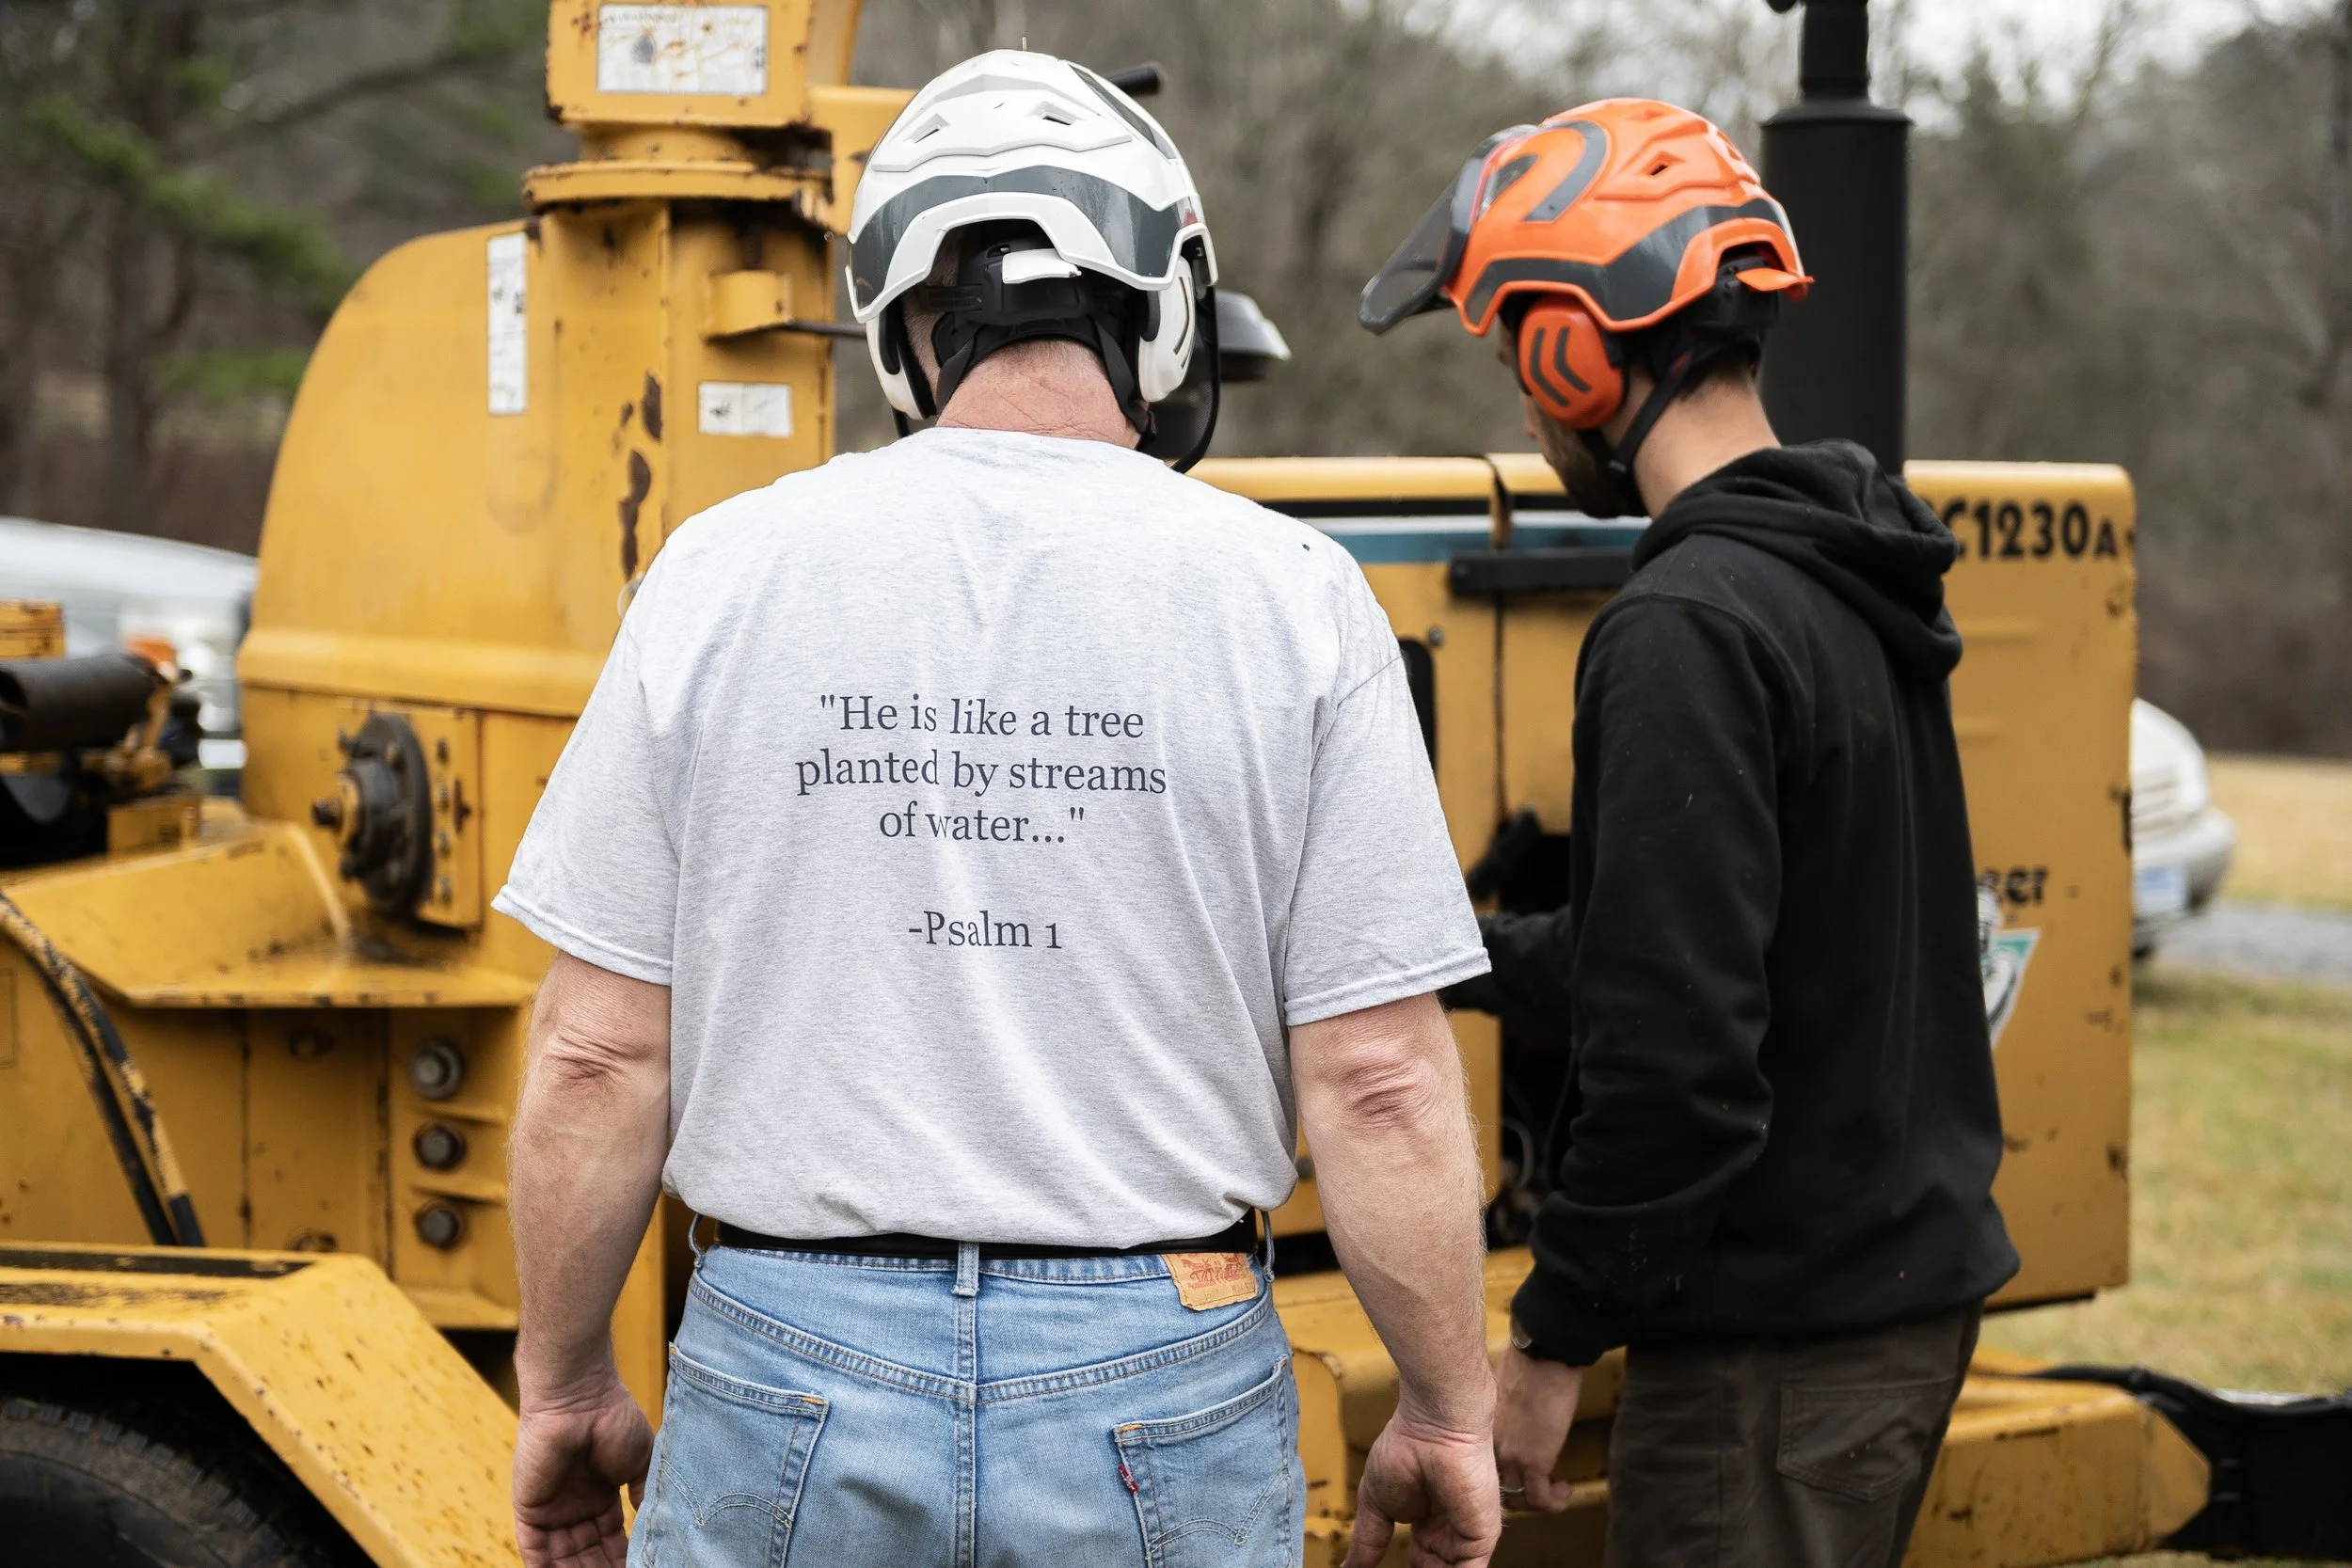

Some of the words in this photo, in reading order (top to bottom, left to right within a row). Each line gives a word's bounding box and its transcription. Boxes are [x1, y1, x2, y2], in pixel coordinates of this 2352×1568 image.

[1921, 498, 2118, 559] C1230A
[820, 694, 898, 730] "He
[910, 693, 937, 732] is
[949, 698, 1017, 736] like
[1030, 711, 1052, 736] a
[1064, 705, 1144, 738] tree
[794, 748, 940, 797] planted
[951, 751, 999, 798] by
[1009, 757, 1167, 794] streams
[879, 800, 918, 838] of
[924, 806, 1085, 844] water..."
[908, 910, 1033, 948] -Psalm
[1045, 923, 1062, 949] 1
